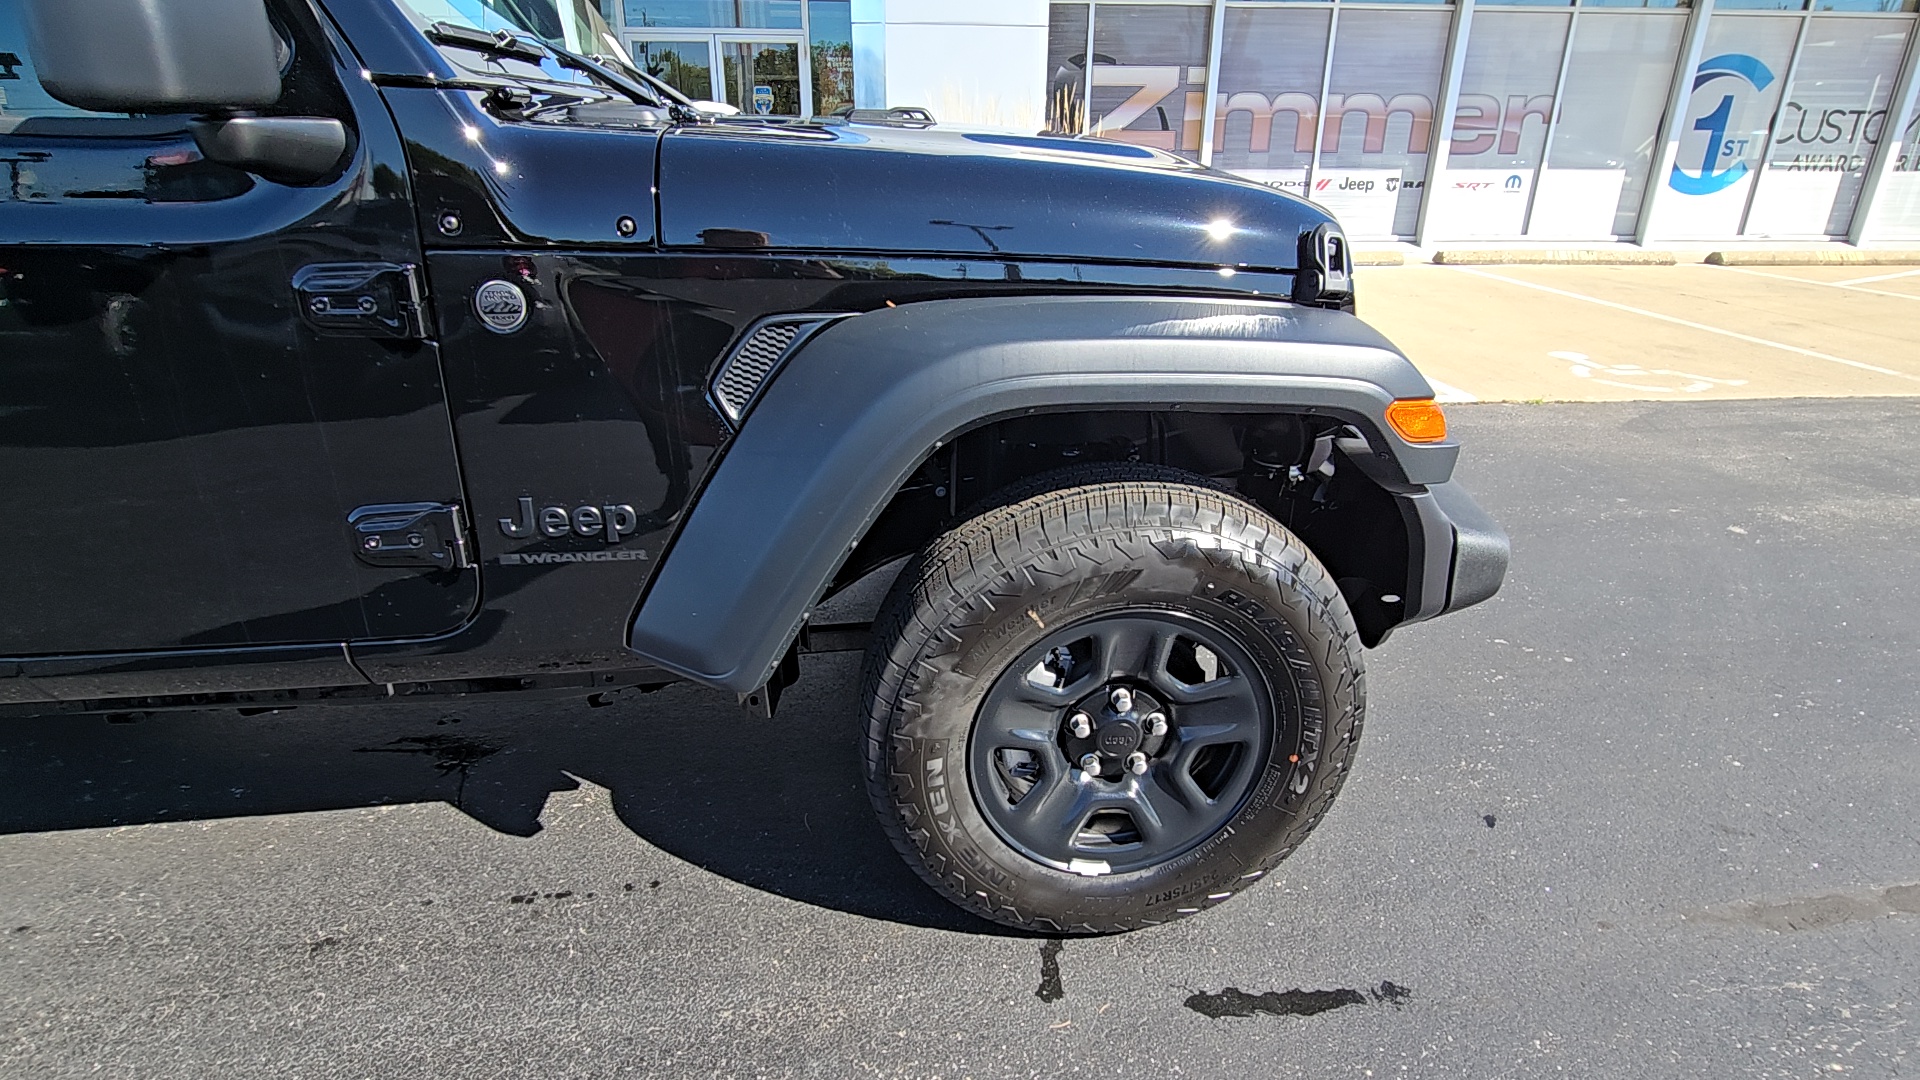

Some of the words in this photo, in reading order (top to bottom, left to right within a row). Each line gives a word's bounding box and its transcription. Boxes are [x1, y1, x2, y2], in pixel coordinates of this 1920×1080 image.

[1091, 64, 1562, 155] Zimmer
[1776, 101, 1888, 144] CUSTO
[1338, 177, 1375, 193] Jeep
[1403, 180, 1425, 189] RA
[1451, 182, 1495, 191] SRT
[498, 497, 637, 543] Jeep
[520, 549, 649, 564] WRANGLER
[926, 757, 1008, 889] NEXEN
